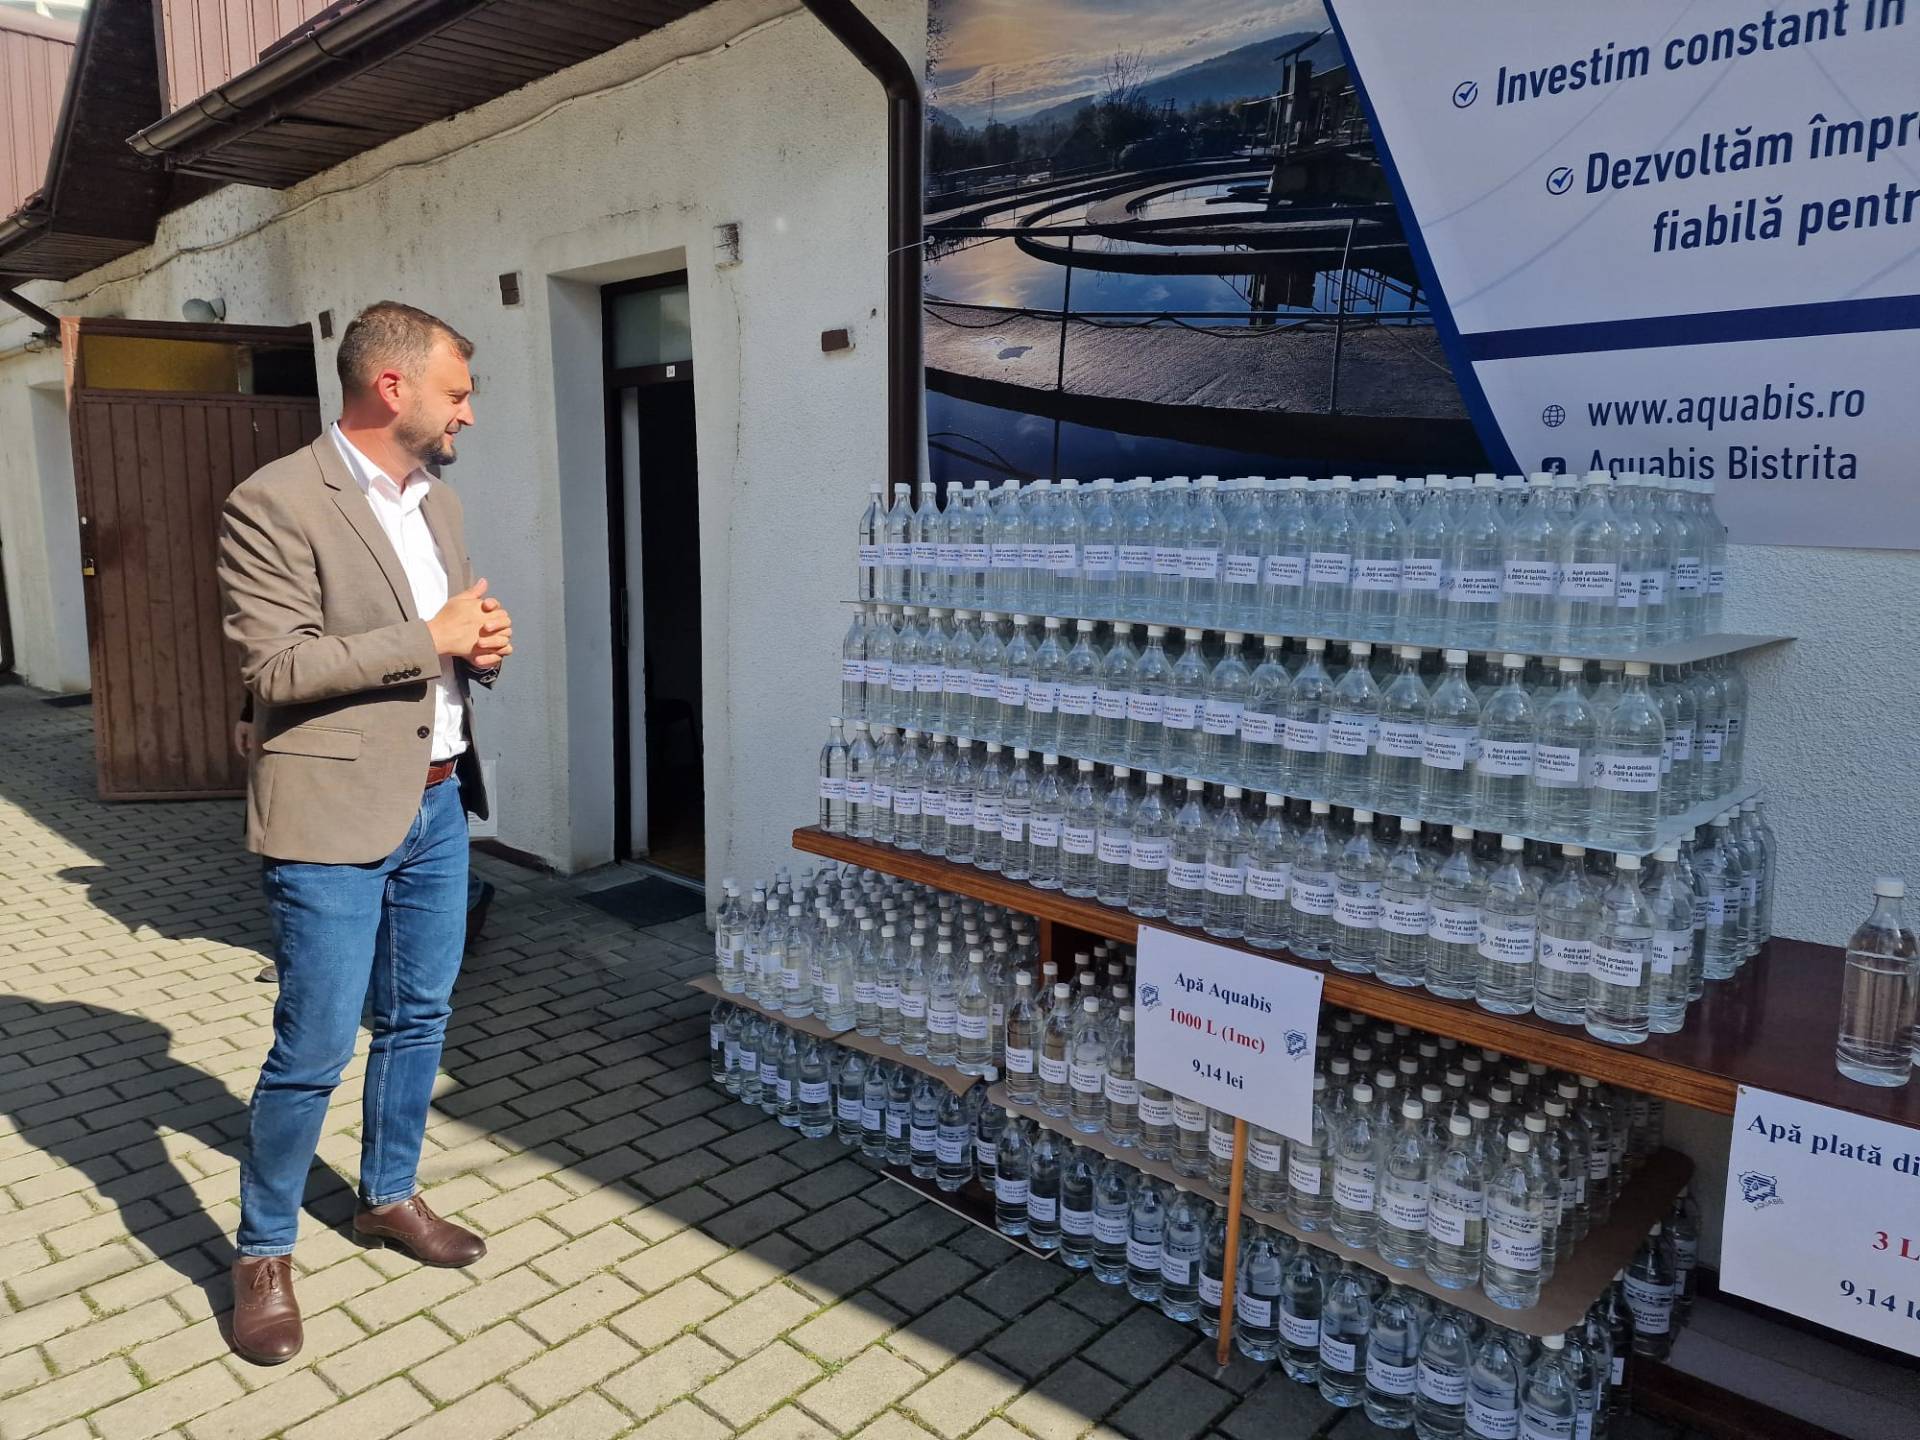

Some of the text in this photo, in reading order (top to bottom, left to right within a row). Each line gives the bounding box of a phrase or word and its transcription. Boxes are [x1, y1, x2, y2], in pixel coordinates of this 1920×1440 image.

[1496, 42, 1650, 106] Investim
[1664, 3, 1848, 70] constant
[1586, 111, 1920, 194] Dezvoltăm împr
[1652, 194, 1785, 253] fiabilă
[1588, 382, 1865, 431] www.aquabis.ro
[1728, 445, 1857, 480] Bistrita
[1174, 972, 1272, 1014] Apă Aquabis
[1169, 1008, 1265, 1054] 1000 L (1mc)
[1192, 1059, 1244, 1090] 9,14 lei
[1746, 1114, 1801, 1144] Apă
[1810, 1133, 1881, 1166] plată
[1872, 1231, 1888, 1250] 3
[1840, 1280, 1896, 1312] 9,14
